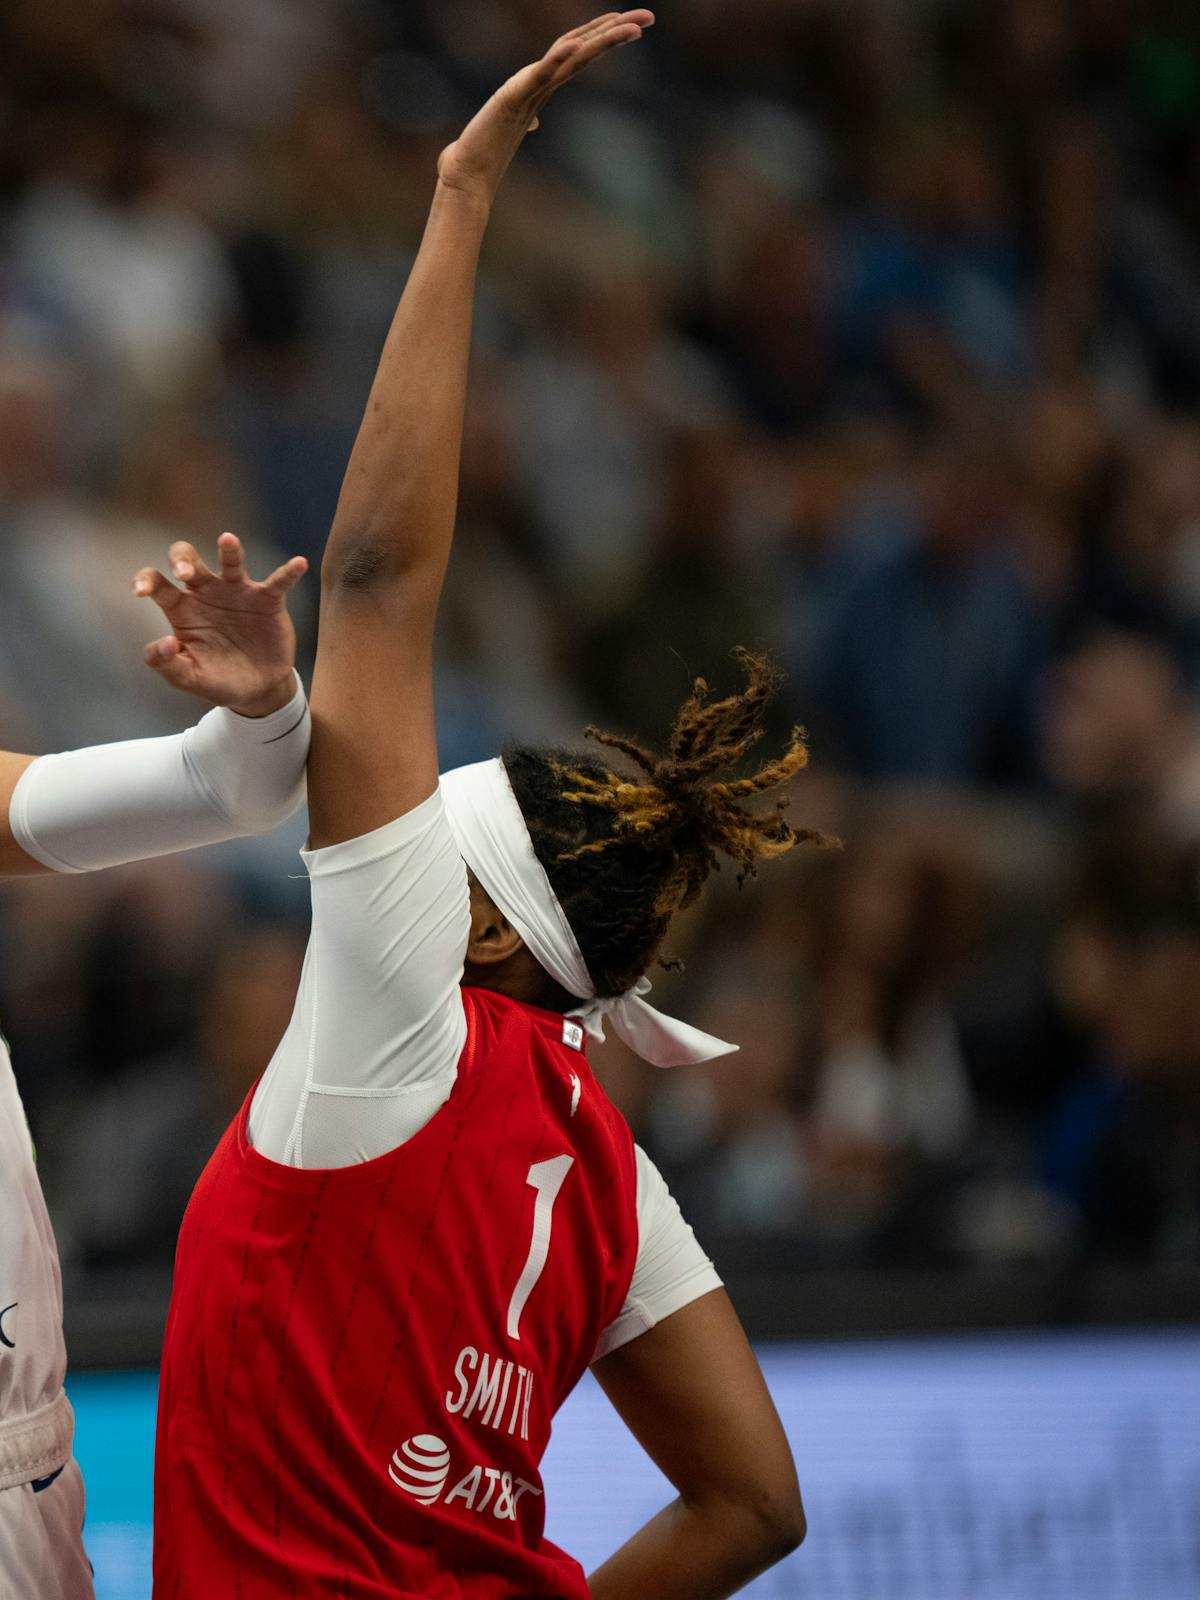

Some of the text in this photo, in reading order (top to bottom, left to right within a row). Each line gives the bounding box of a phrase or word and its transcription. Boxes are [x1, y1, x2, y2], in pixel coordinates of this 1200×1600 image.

[507, 1154, 574, 1340] 1
[445, 1346, 534, 1441] SMITH
[444, 1465, 543, 1521] AT&T
